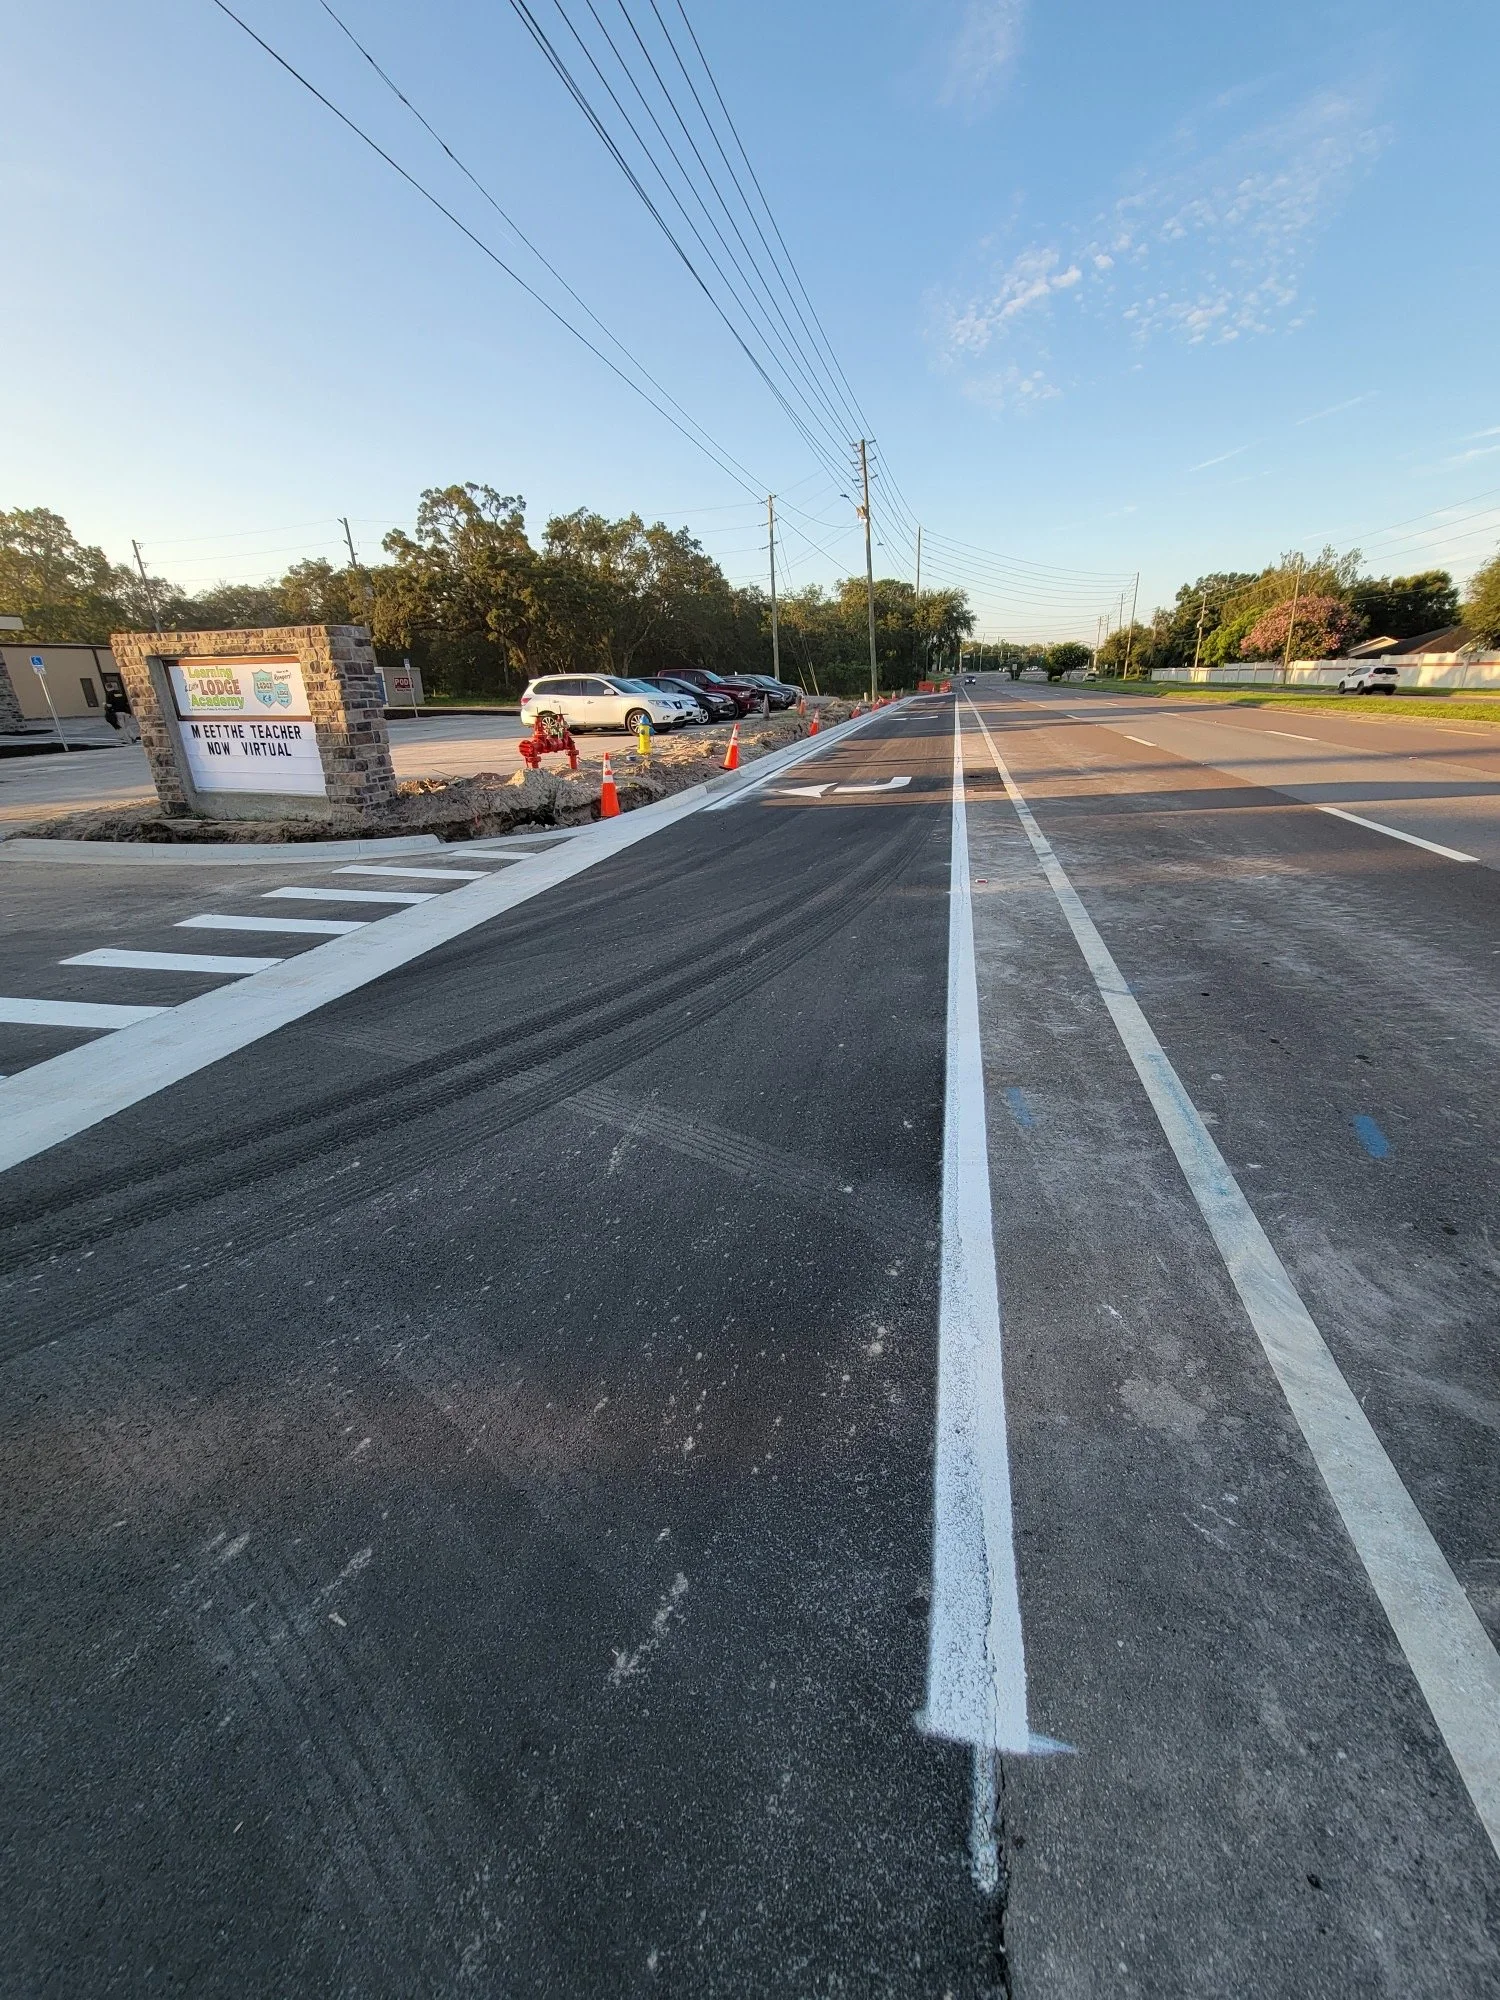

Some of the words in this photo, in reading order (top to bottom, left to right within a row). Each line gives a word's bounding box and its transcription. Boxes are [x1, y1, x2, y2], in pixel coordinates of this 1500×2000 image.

[187, 666, 233, 679] Learning
[199, 679, 242, 695] LODGE
[191, 694, 244, 709] Academy
[191, 724, 222, 738] MEET
[223, 724, 245, 738] THE
[250, 725, 302, 739] TEACHER
[207, 741, 230, 755] NOW
[241, 741, 292, 756] VIRTUAL
